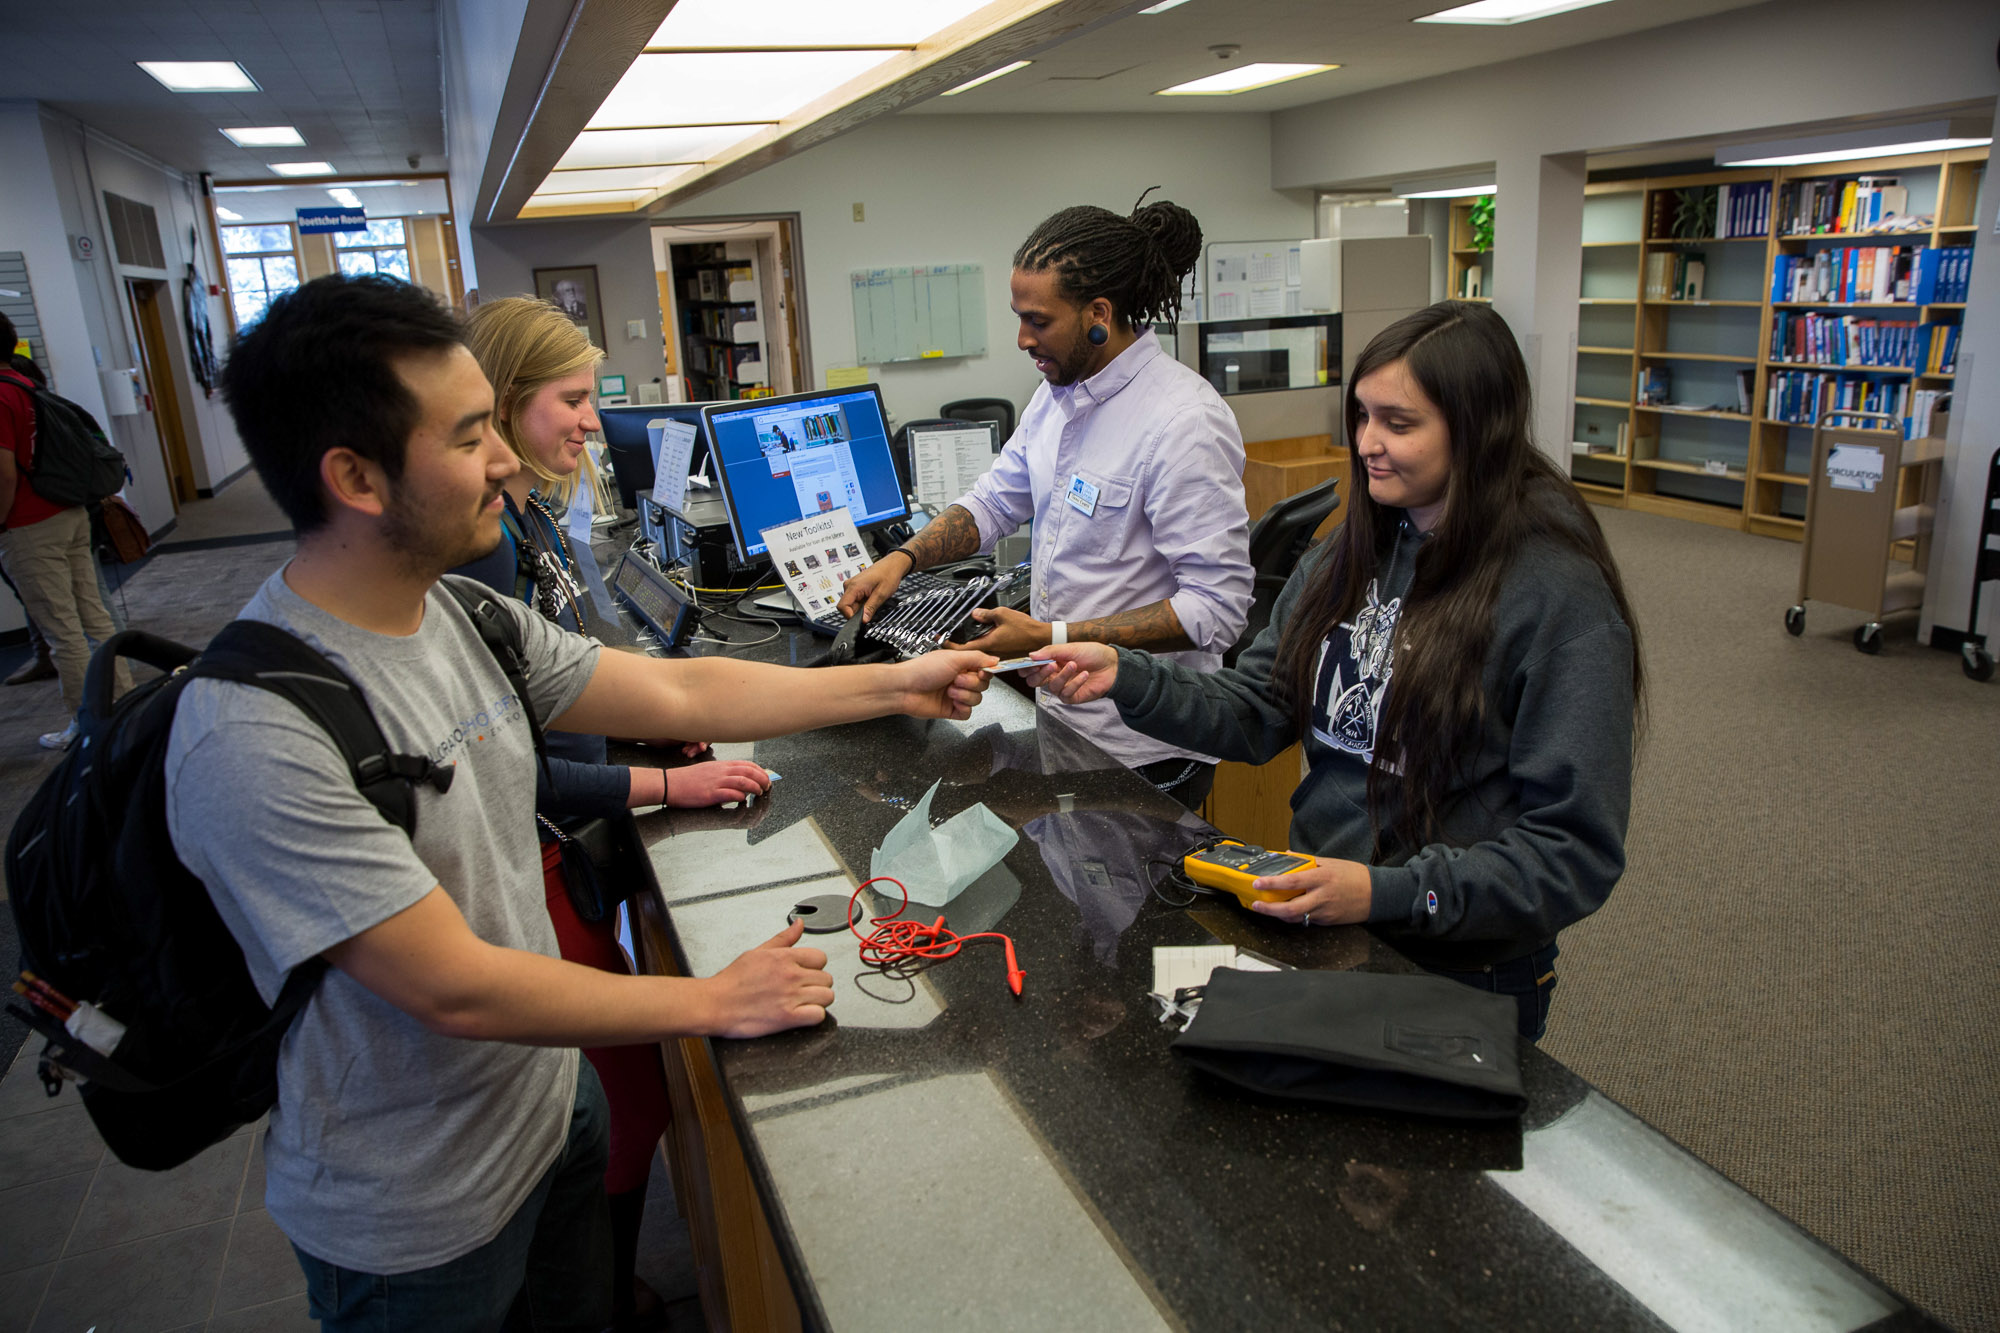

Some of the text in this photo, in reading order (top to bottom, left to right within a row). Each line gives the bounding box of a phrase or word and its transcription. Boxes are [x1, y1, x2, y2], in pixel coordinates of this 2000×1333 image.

[298, 213, 366, 227] Boettcher Room
[1826, 466, 1882, 480] CIRCULATION
[785, 519, 834, 542] New Toolkits!
